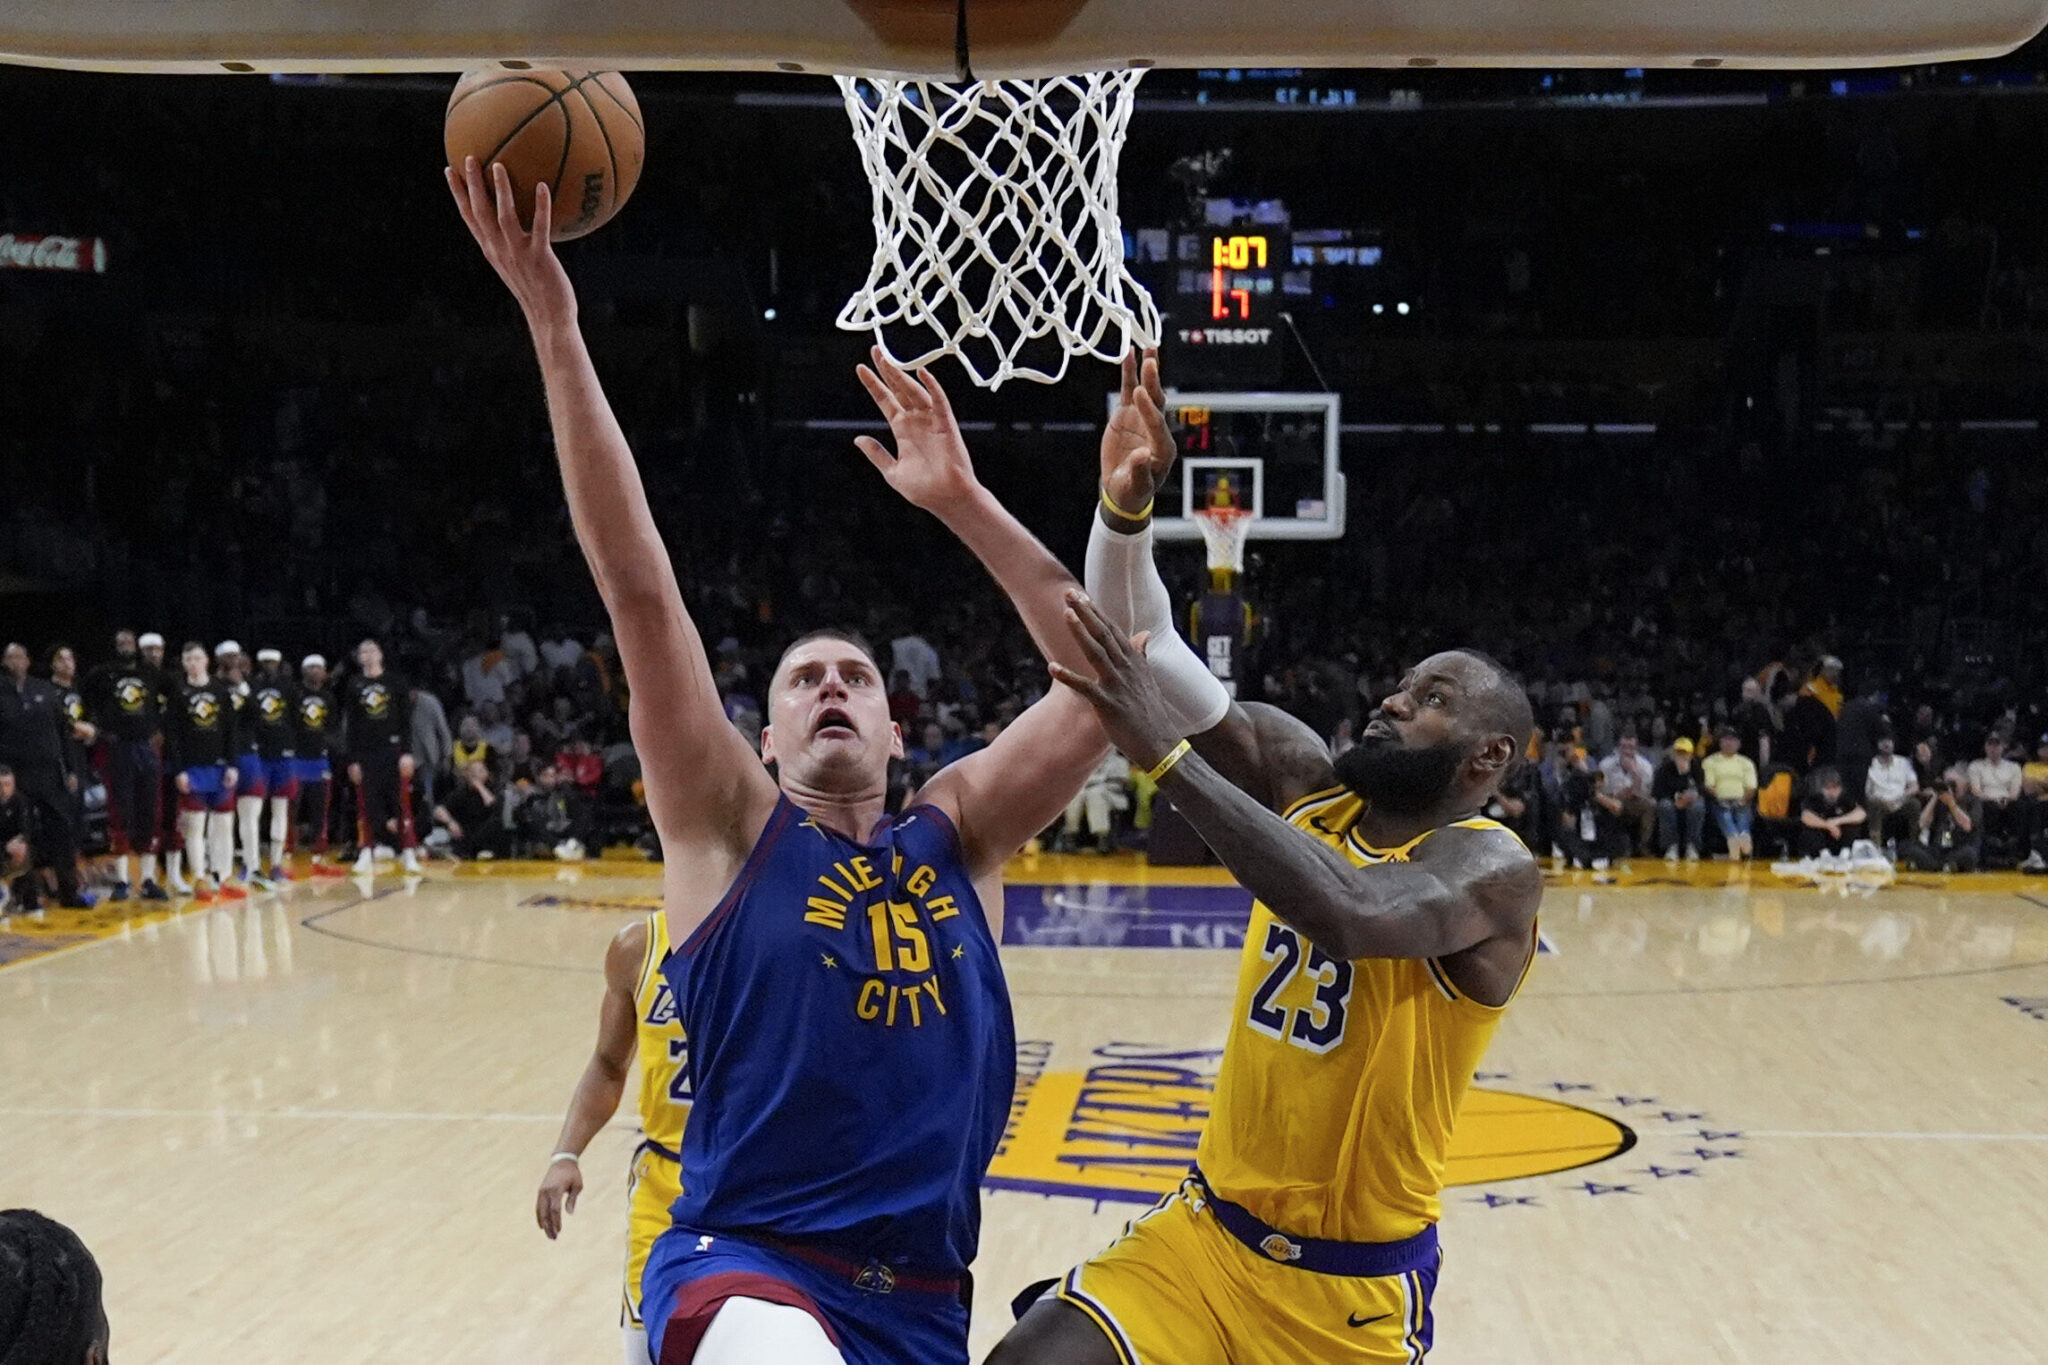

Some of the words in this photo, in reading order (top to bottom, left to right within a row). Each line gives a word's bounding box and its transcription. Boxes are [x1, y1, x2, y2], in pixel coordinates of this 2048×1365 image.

[1212, 236, 1268, 270] 1:07
[1205, 329, 1272, 344] TISSOT
[803, 856, 884, 931] MILE
[866, 898, 931, 973] 15
[856, 974, 947, 1027] CITY
[1247, 921, 1356, 1056] 23
